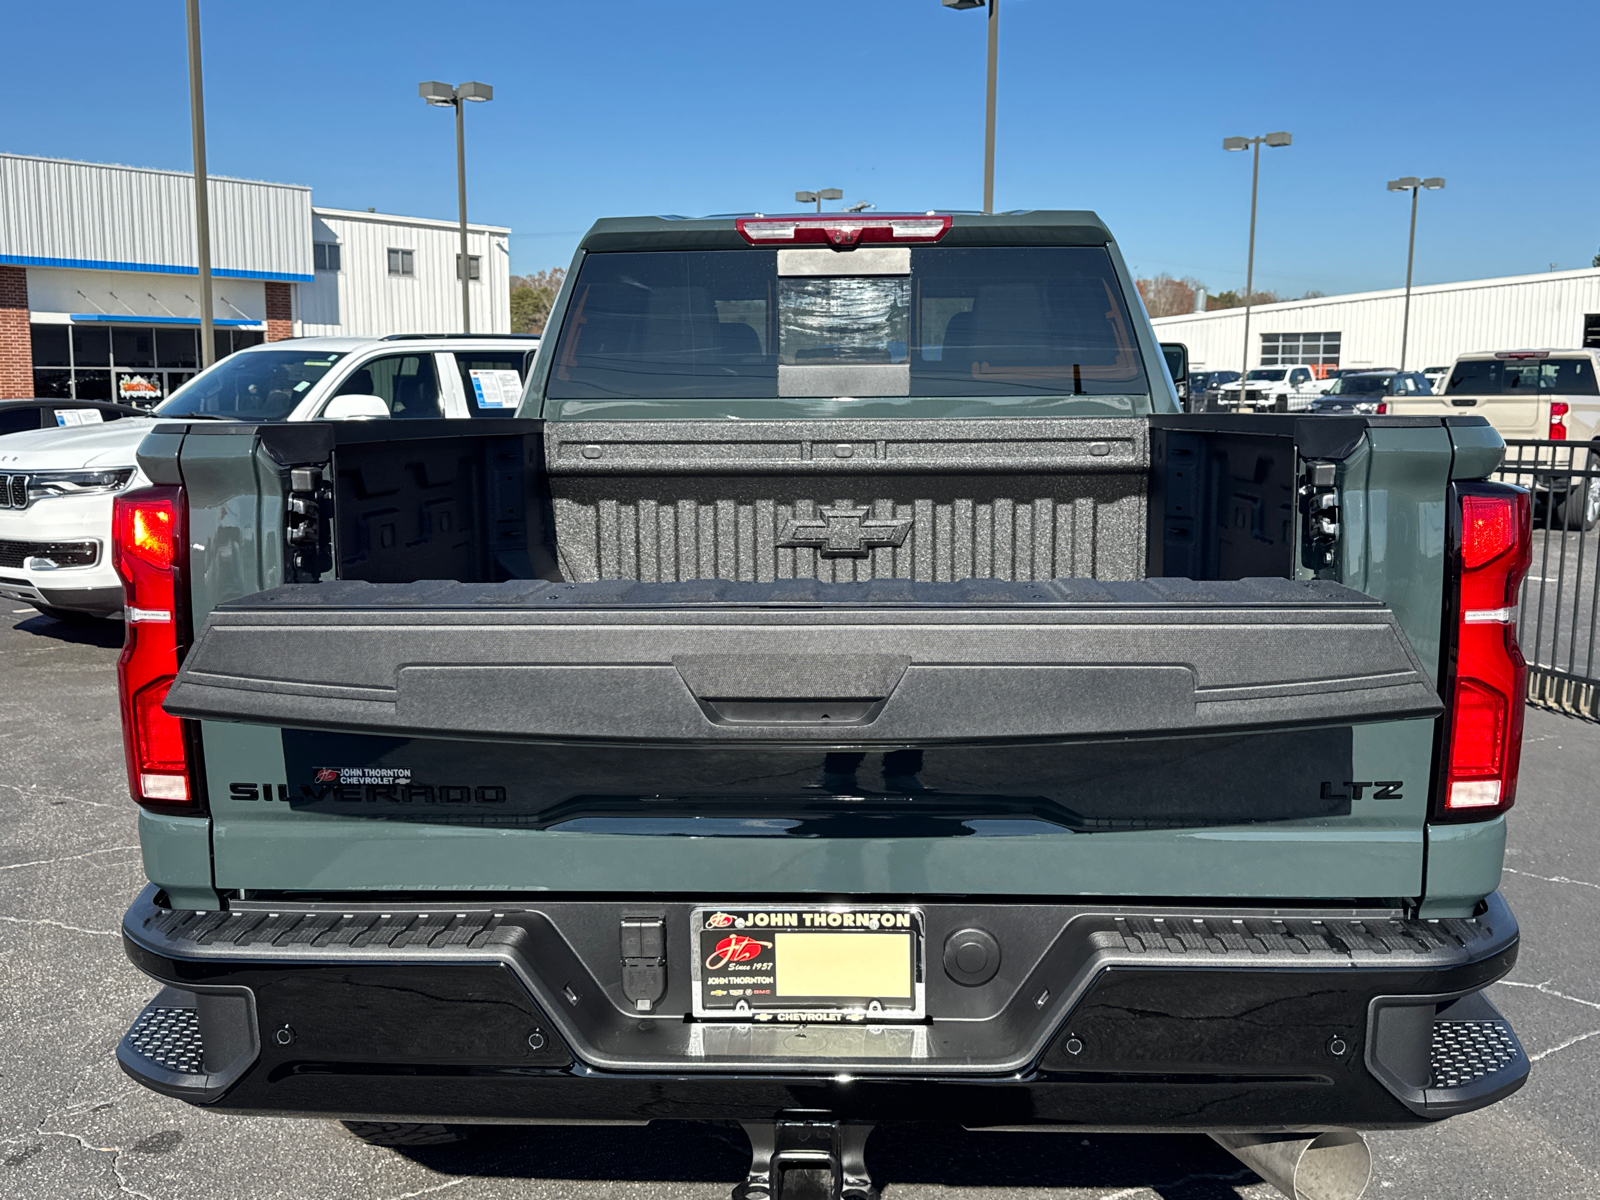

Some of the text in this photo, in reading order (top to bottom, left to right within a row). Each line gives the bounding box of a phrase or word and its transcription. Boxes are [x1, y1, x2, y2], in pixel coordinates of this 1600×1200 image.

[340, 768, 411, 777] JOHN THORNTON
[340, 776, 394, 784] CHEVROLET
[229, 783, 506, 804] SILVERADO
[1320, 781, 1403, 800] LTZ
[745, 913, 911, 927] JOHN THORNTON
[727, 962, 773, 971] Since 1957
[707, 976, 774, 985] JOHN THORNTON
[777, 1013, 842, 1022] CHEVROLET
